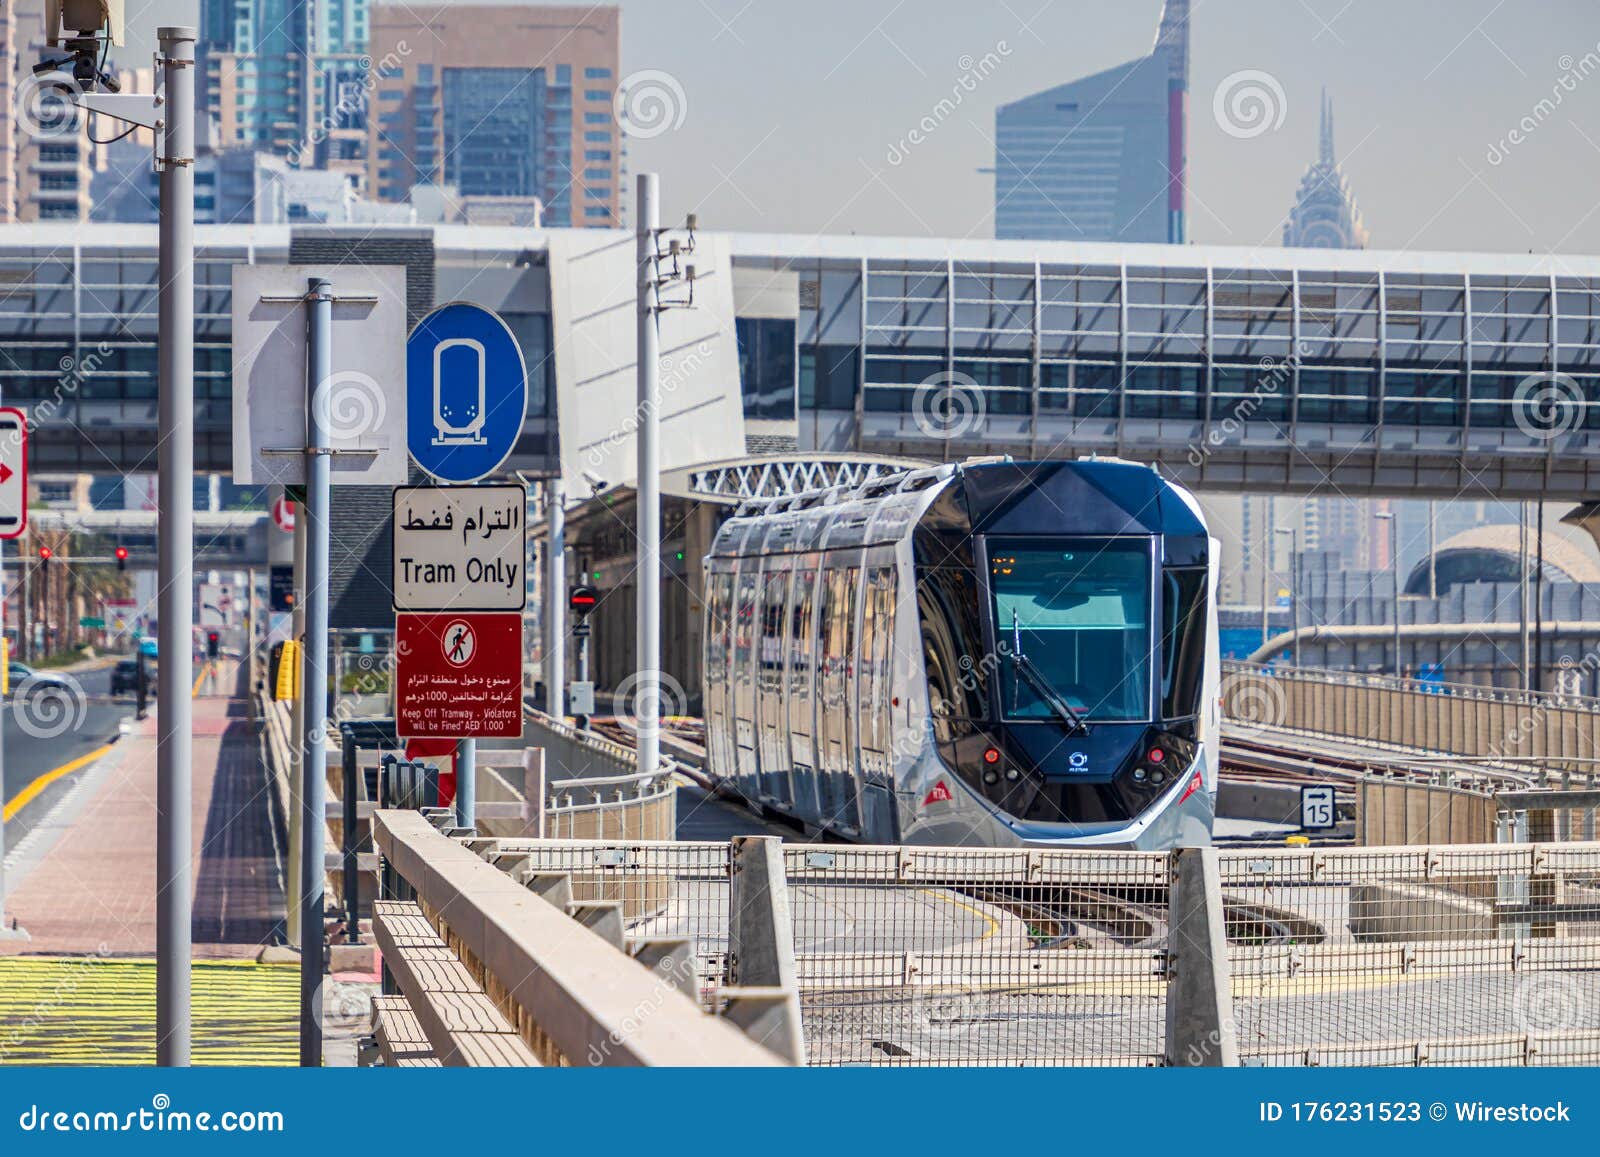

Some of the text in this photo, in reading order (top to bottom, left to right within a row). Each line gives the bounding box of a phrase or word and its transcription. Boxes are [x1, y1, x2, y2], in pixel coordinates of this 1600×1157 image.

[463, 505, 518, 546] الترام
[400, 557, 518, 588] Tram Only
[402, 708, 421, 720] Keep
[424, 708, 437, 718] Off
[440, 708, 474, 720] Tramway
[483, 708, 517, 719] Violators
[412, 720, 426, 730] will
[428, 720, 438, 730] be
[441, 720, 461, 730] Fined
[464, 720, 480, 730] AED
[1307, 804, 1330, 824] 15
